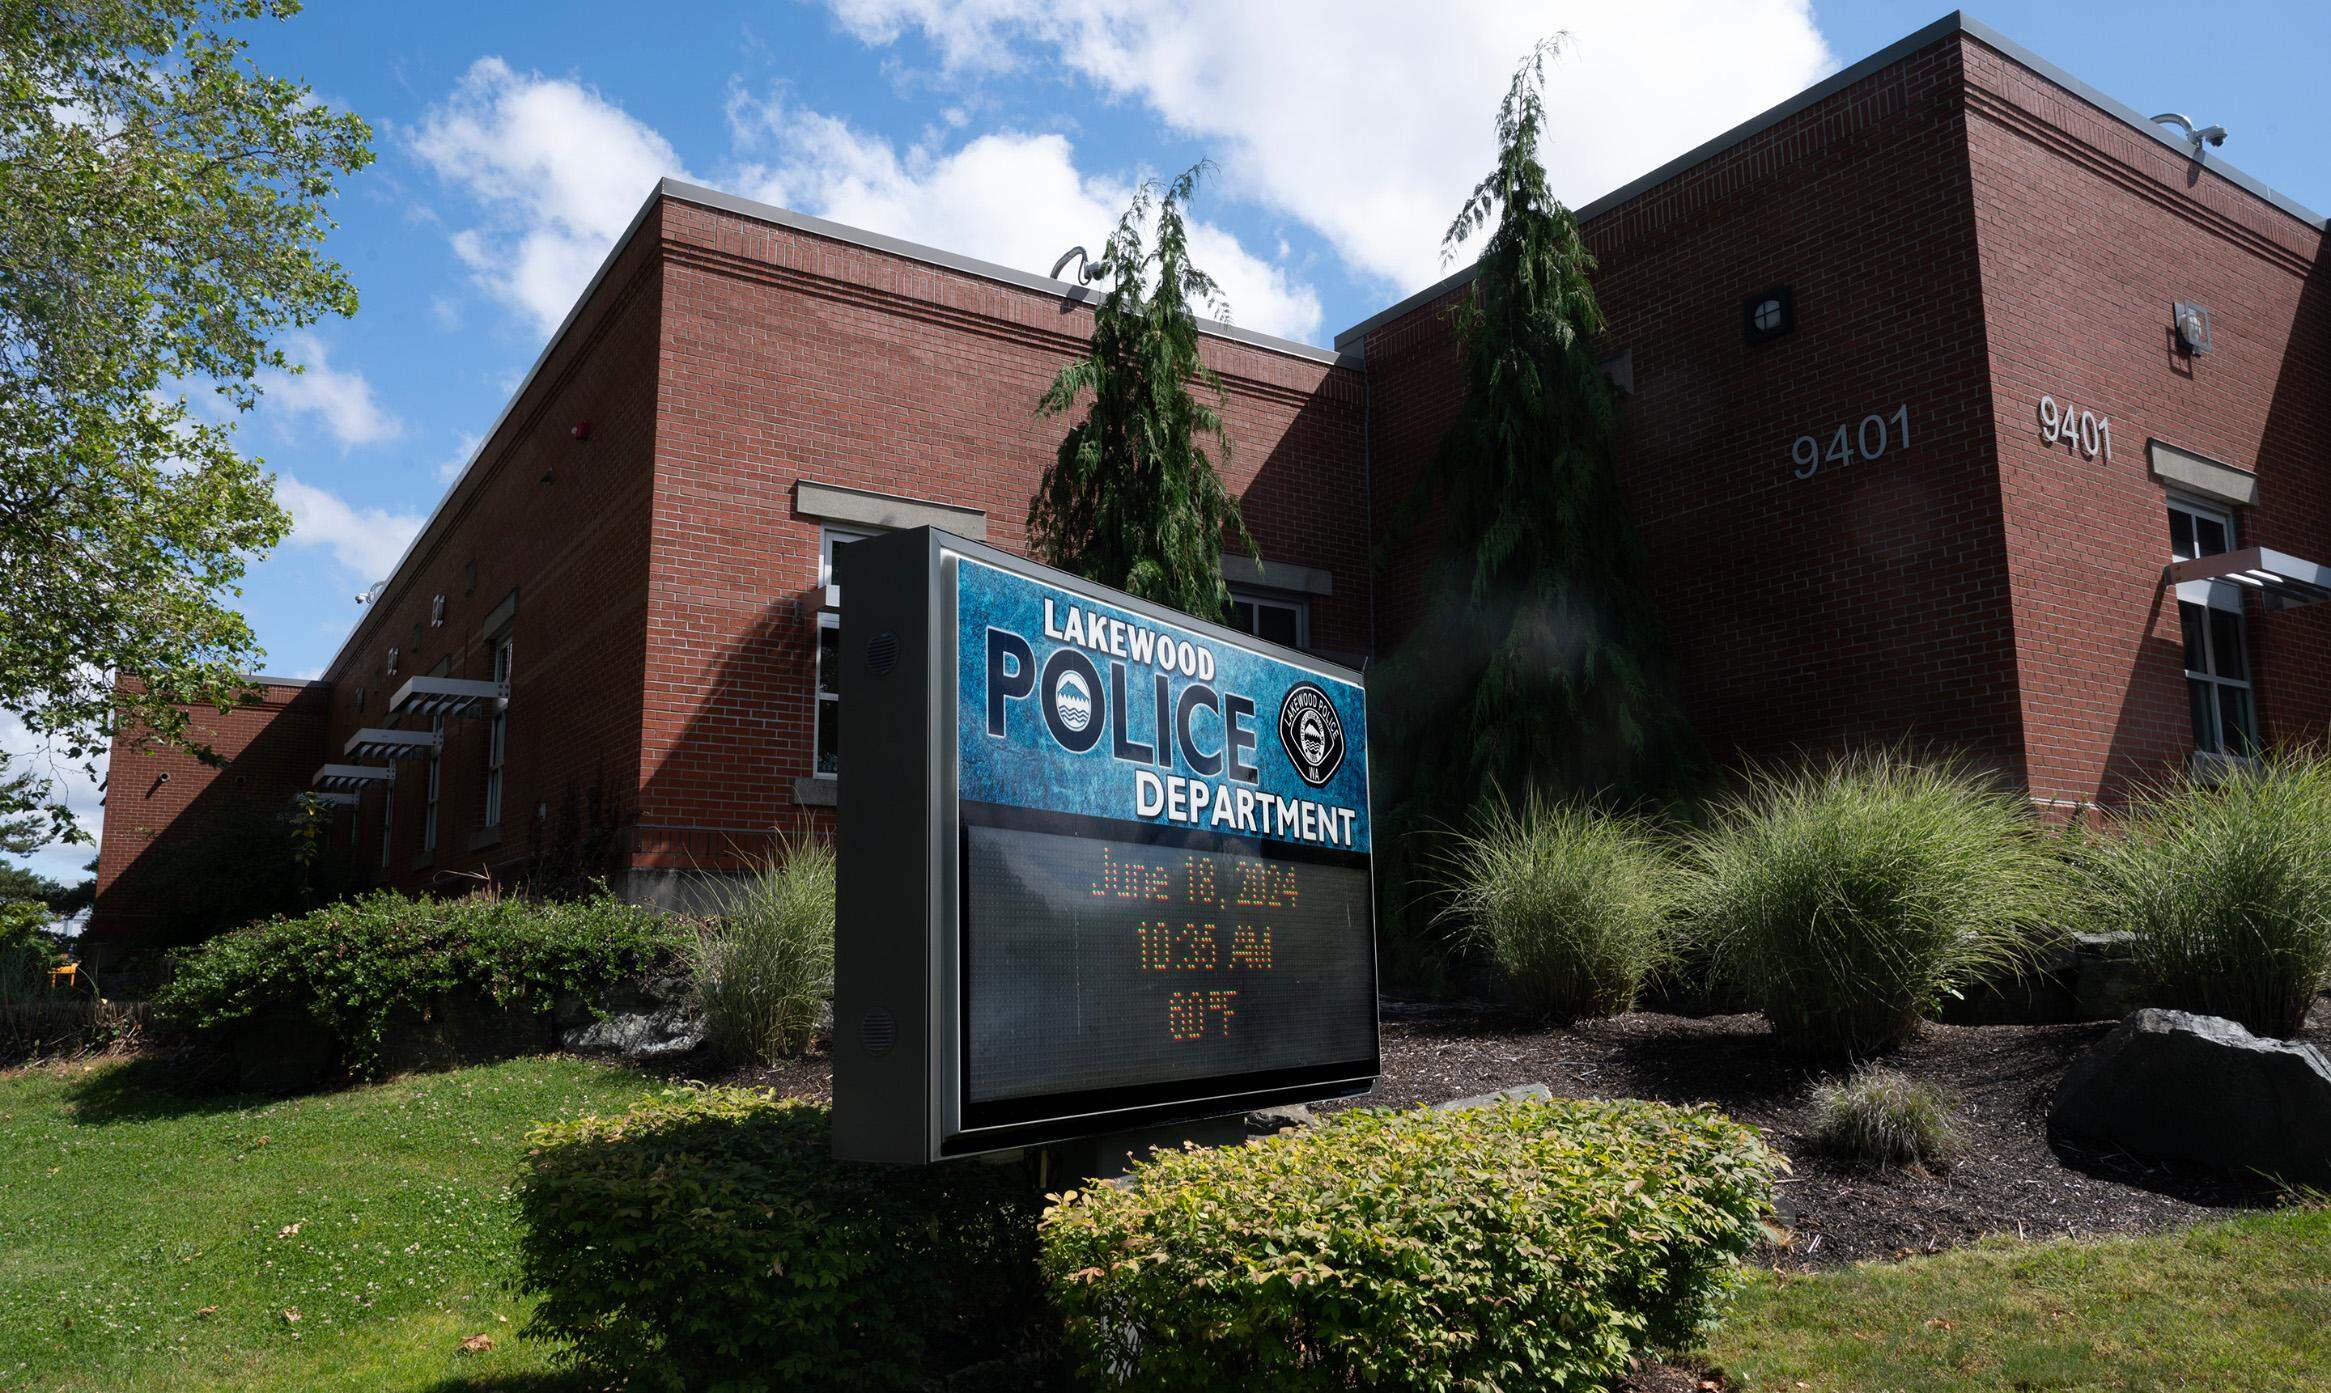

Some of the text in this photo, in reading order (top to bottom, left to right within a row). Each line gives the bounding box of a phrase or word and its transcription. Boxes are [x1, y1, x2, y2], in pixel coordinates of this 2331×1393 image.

[1791, 404, 1911, 480] 9401
[2040, 395, 2112, 462] 9401
[1043, 599, 1215, 682] LAKEWOOD
[987, 626, 1260, 785] POLICE
[1284, 692, 1318, 728] LAKEWOOD
[1319, 699, 1340, 741] POLICE
[1308, 766, 1320, 781] WA
[1136, 770, 1357, 847] DEPARTMENT
[1091, 847, 1170, 900] June
[1235, 860, 1299, 908] 2024
[1228, 924, 1273, 969] AM
